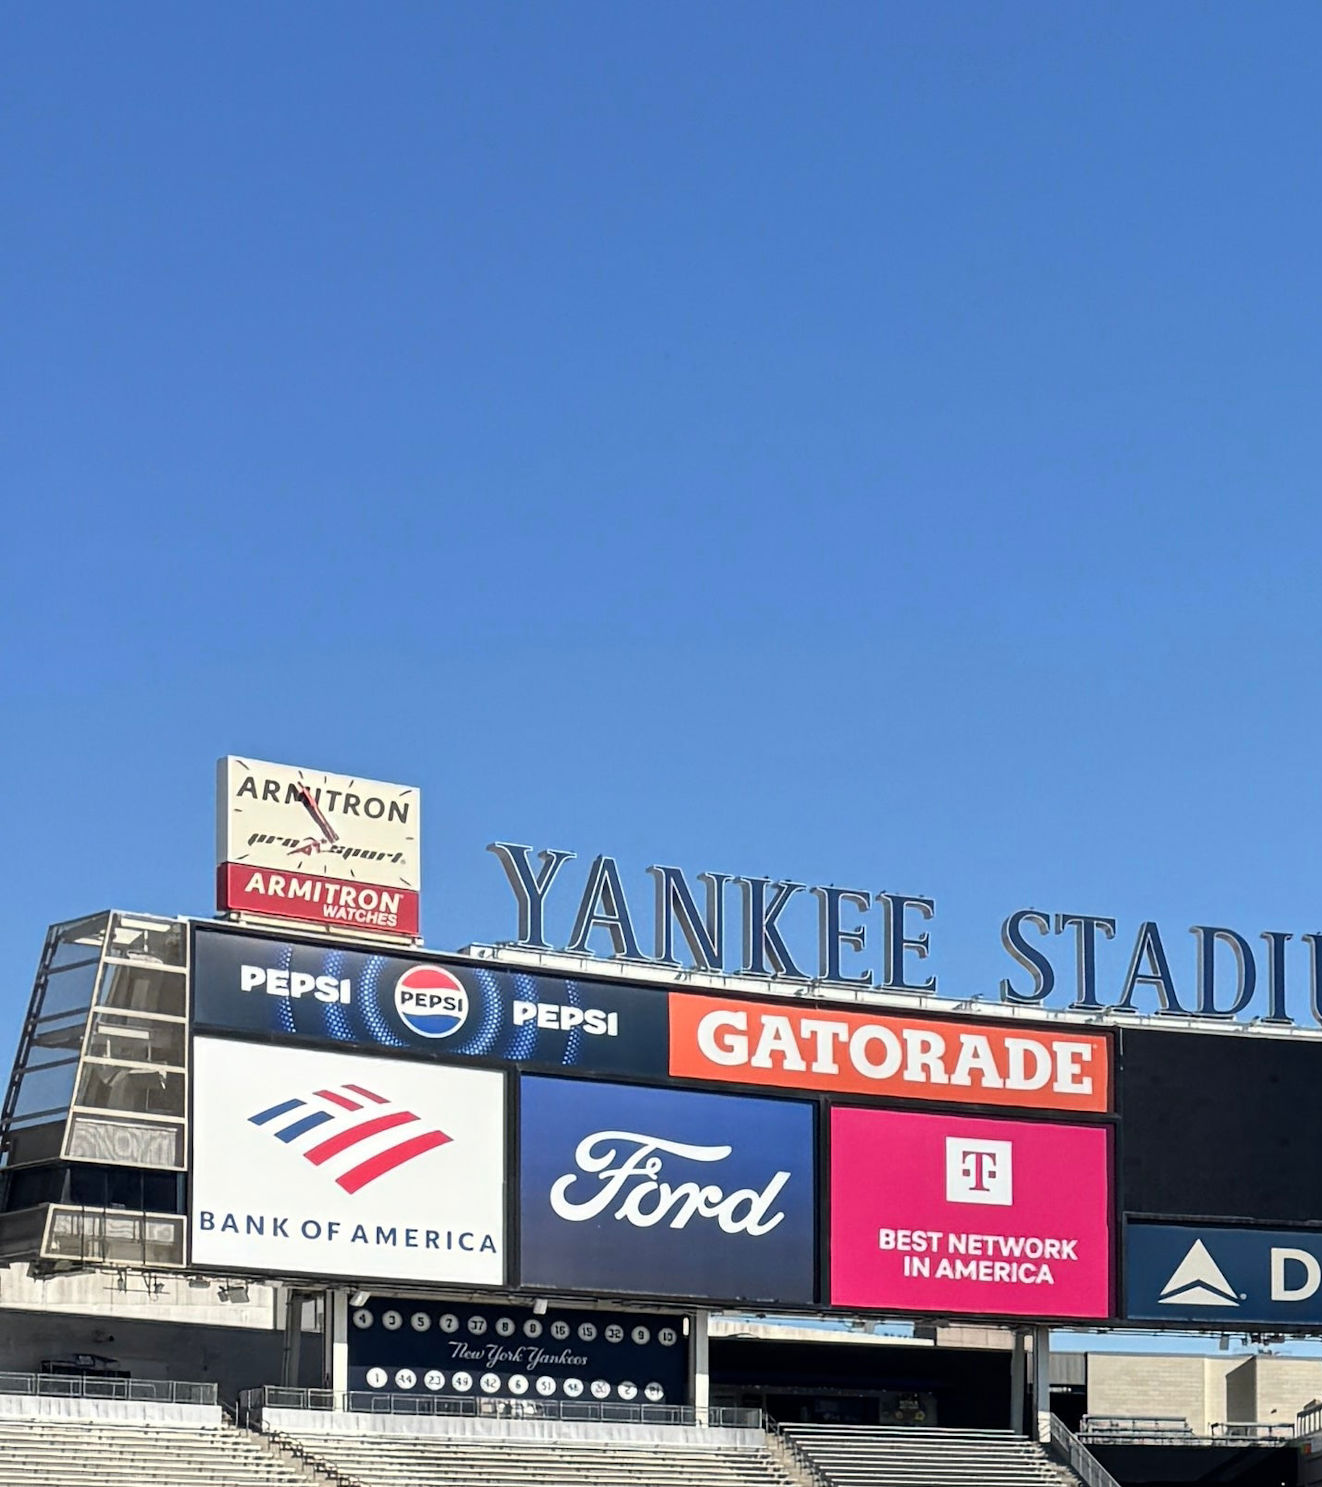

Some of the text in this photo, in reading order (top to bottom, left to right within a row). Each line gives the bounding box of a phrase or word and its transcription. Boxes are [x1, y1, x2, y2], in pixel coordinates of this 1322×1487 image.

[236, 776, 410, 824] ARMITRON
[244, 872, 402, 914] ARMITRON
[322, 904, 399, 927] WATCHES
[486, 841, 937, 994] YANKEE
[240, 965, 351, 1004] PEPSI
[401, 990, 464, 1013] PEPSI
[513, 1001, 618, 1037] PEPSI
[697, 1010, 1095, 1096] GATORADE
[549, 1129, 792, 1238] Ford
[199, 1210, 498, 1254] BANK OF AMERICA
[878, 1228, 1079, 1262] BEST NETWORK
[903, 1255, 1056, 1286] IN AMERICA
[470, 1320, 485, 1331] 37
[448, 1341, 589, 1371] New York Yankees
